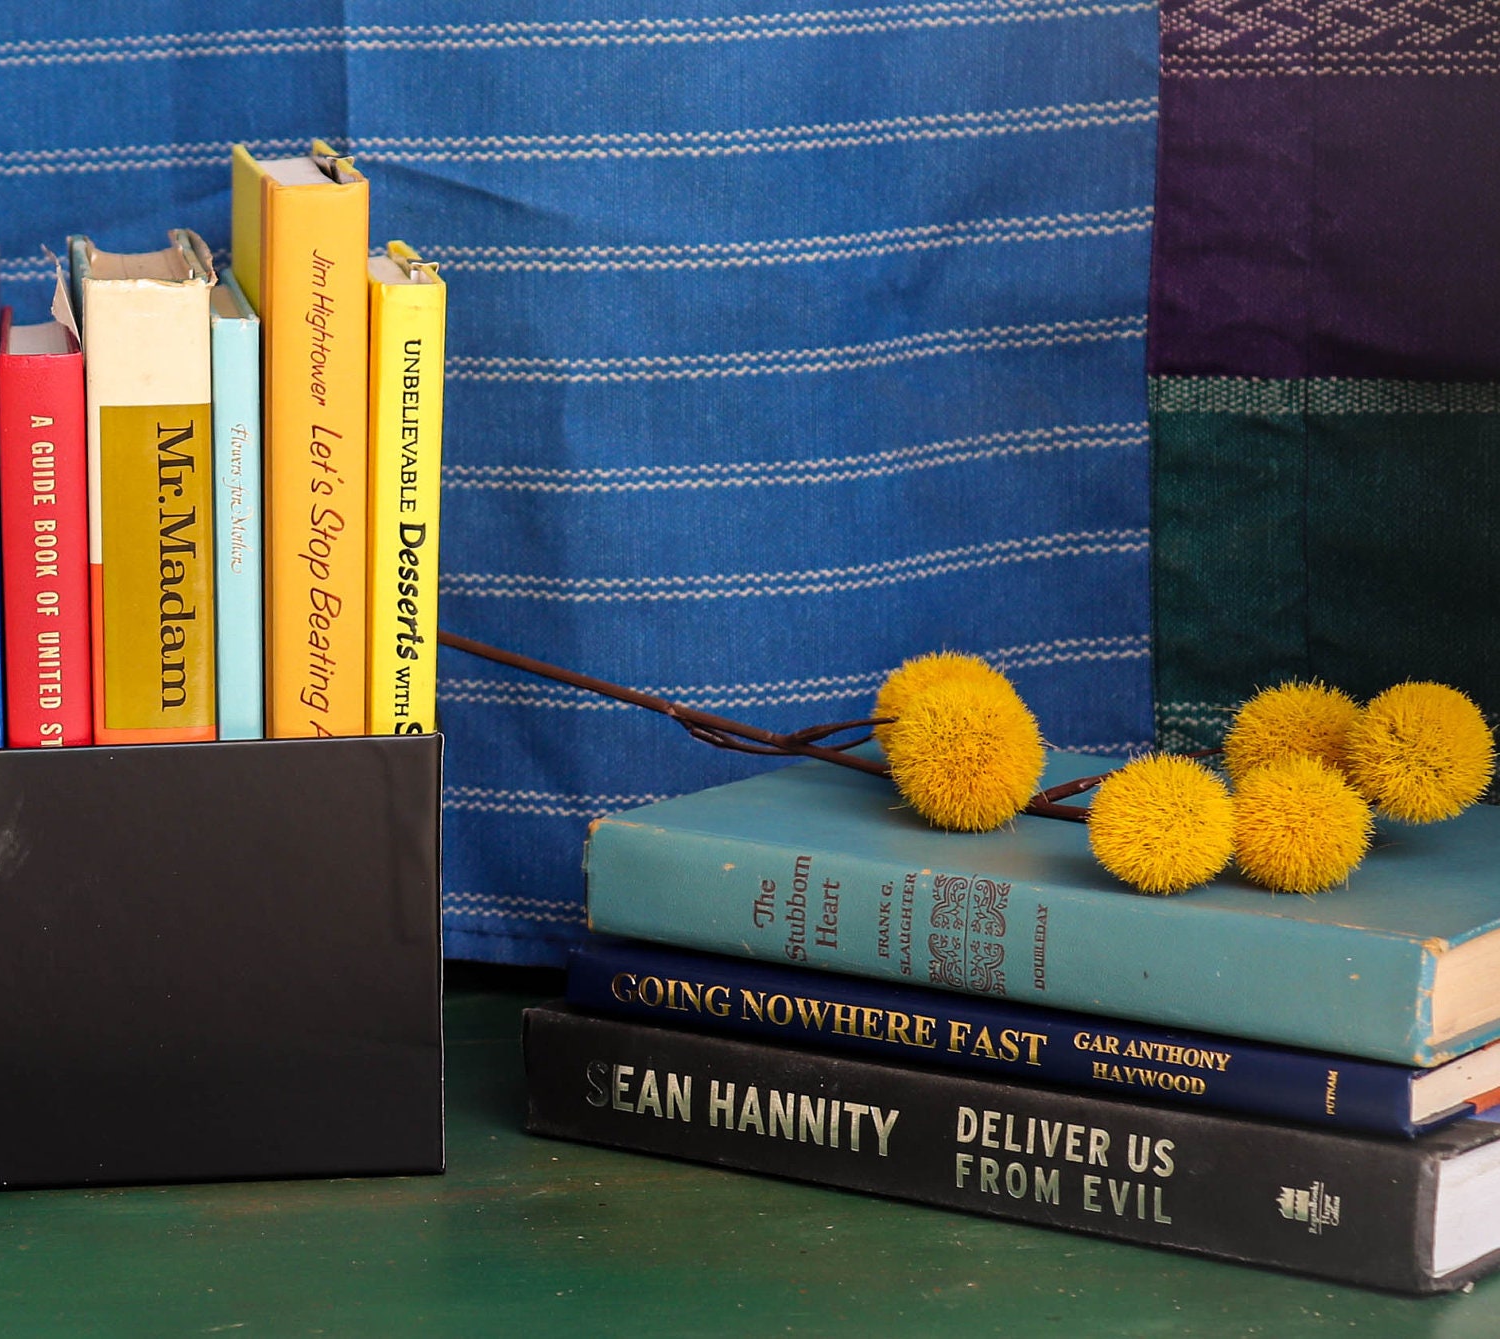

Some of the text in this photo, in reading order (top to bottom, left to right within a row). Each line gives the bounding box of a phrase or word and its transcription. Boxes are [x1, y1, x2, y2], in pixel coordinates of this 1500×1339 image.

[312, 249, 335, 287] Jim
[305, 292, 335, 407] Hightower
[30, 415, 54, 428] A
[230, 424, 253, 477] Flowers
[400, 338, 422, 513] UNBELIEVABLE
[30, 441, 56, 506] GUIDE
[311, 423, 343, 497] Let's
[33, 519, 58, 579] BOOK
[230, 506, 253, 574] Mother
[299, 502, 345, 580] Stop
[35, 592, 60, 617] OF
[395, 521, 427, 661] Desserts
[36, 631, 63, 710] UNITED
[301, 587, 342, 713] Beating
[394, 665, 411, 717] WITH
[753, 879, 776, 929] The
[785, 855, 812, 961] Stubborn
[815, 878, 840, 950] Heart
[877, 881, 894, 959] FRANK G.
[900, 873, 917, 976] SLAUGHTER
[1034, 903, 1048, 991] DOUBLEDAY
[611, 972, 1049, 1067] GOING NOWHERE FAST
[1074, 1032, 1232, 1073] GAR ANTHONY
[586, 1060, 899, 1157] SEAN HANNITY
[1092, 1061, 1206, 1095] HAYWOOD
[1326, 1069, 1339, 1115] PUTNAM
[956, 1105, 1177, 1179] DELIVER US
[955, 1152, 1173, 1226] FROM EVIL
